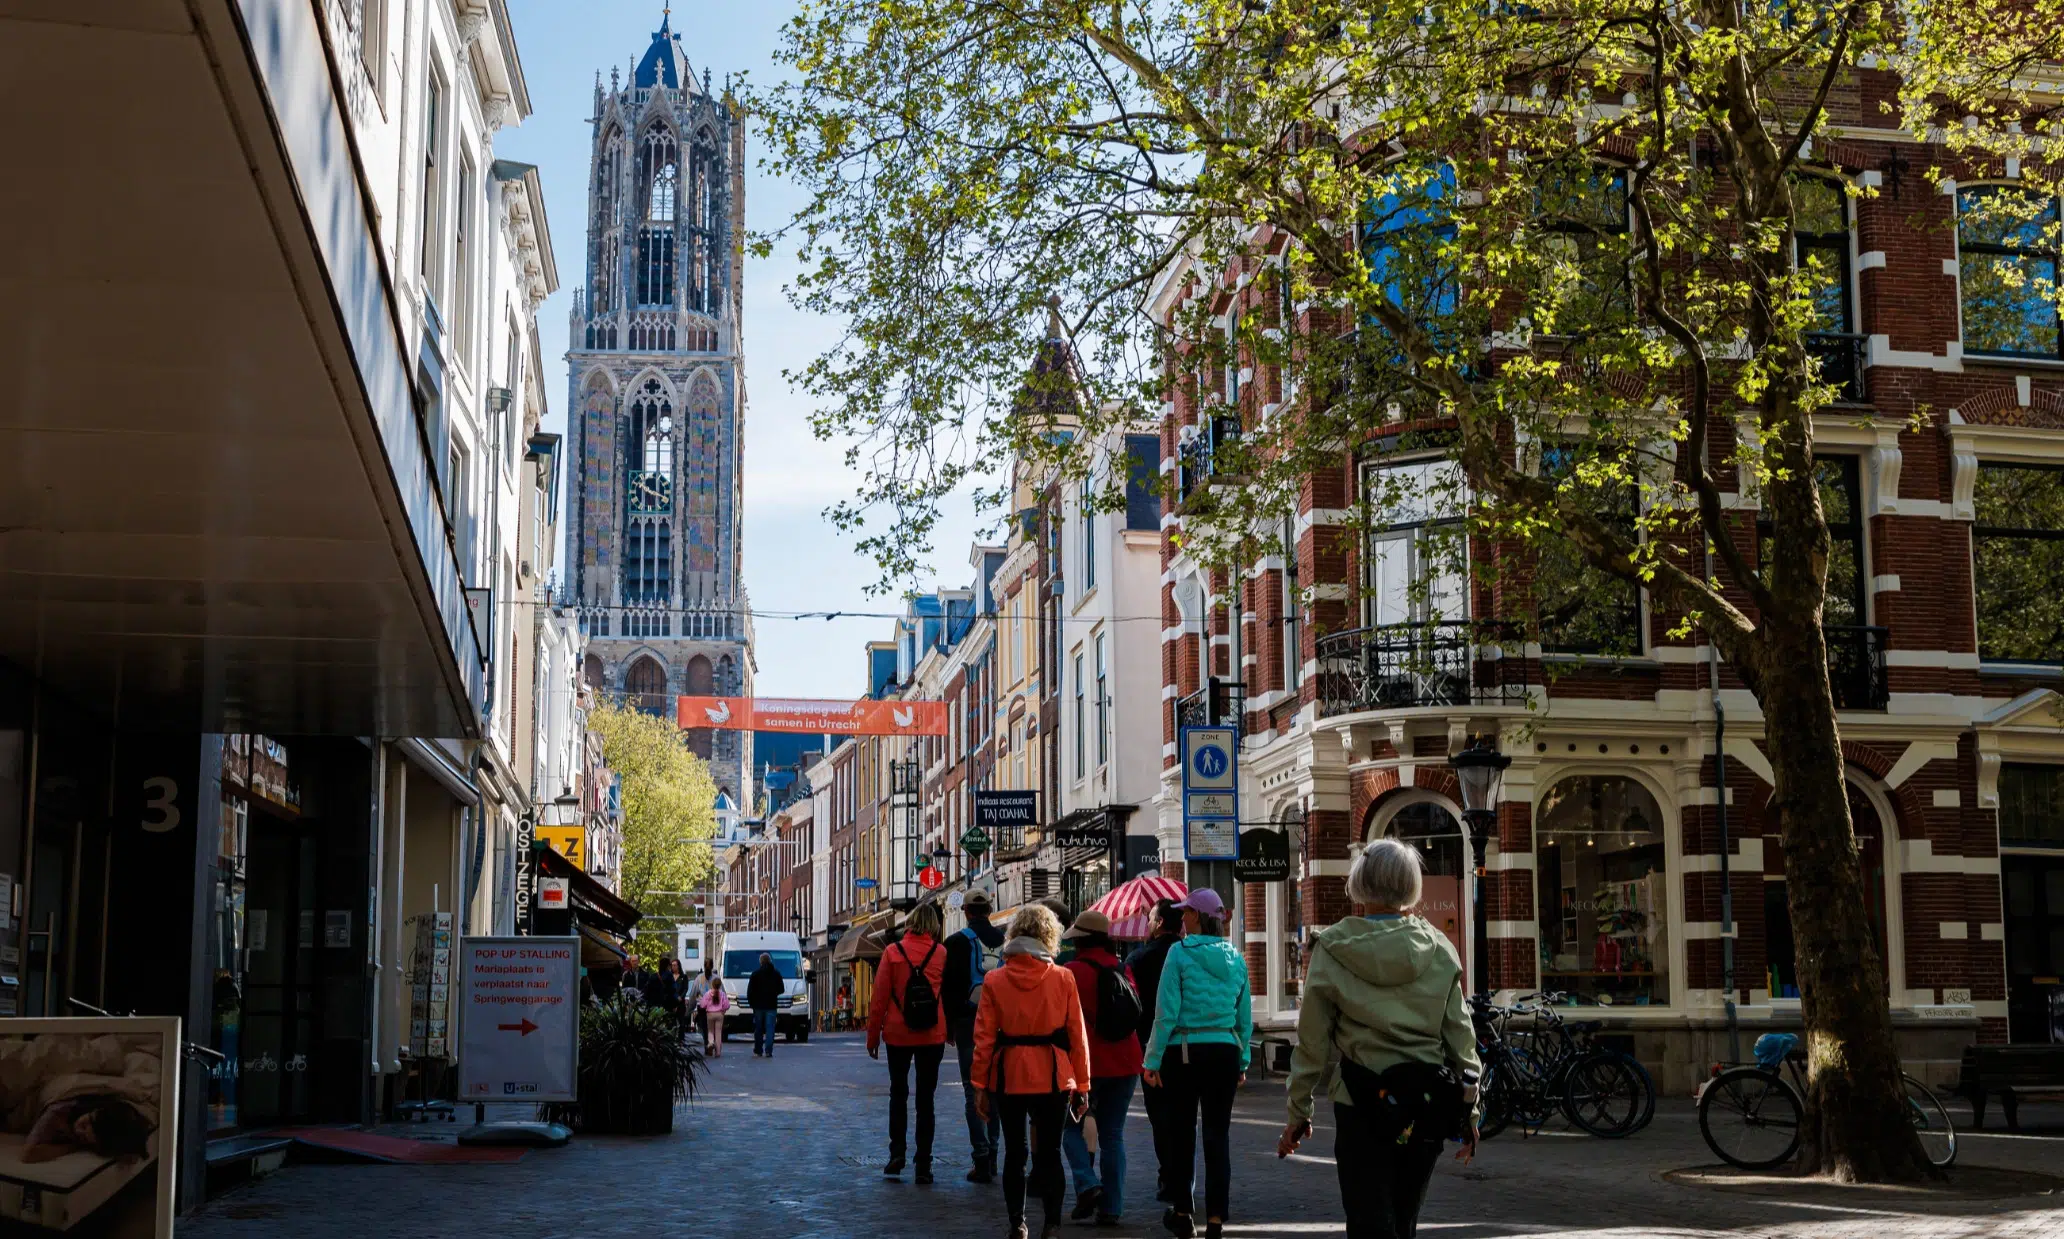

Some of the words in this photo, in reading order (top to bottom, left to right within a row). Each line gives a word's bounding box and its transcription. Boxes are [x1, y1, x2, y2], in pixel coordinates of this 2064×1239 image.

[761, 703, 828, 717] Koningsdag
[854, 706, 865, 718] je
[765, 718, 803, 728] samen
[805, 717, 816, 728] in
[819, 719, 861, 730] Utrecht
[140, 775, 181, 833] 3
[983, 808, 997, 823] TAJ
[999, 808, 1030, 819] MAHAL
[1057, 834, 1108, 846] nukuhiva
[1235, 859, 1257, 868] KECK
[1259, 857, 1267, 868] &
[1269, 859, 1287, 868] LISA
[1433, 899, 1456, 911] LISA
[1570, 900, 1598, 912] KECK
[519, 949, 570, 959] STALLING
[475, 964, 533, 975] Mariaplaats
[536, 965, 544, 974] is
[474, 979, 524, 989] verplaatst
[527, 980, 549, 989] naar
[474, 994, 563, 1005] Springweggarage
